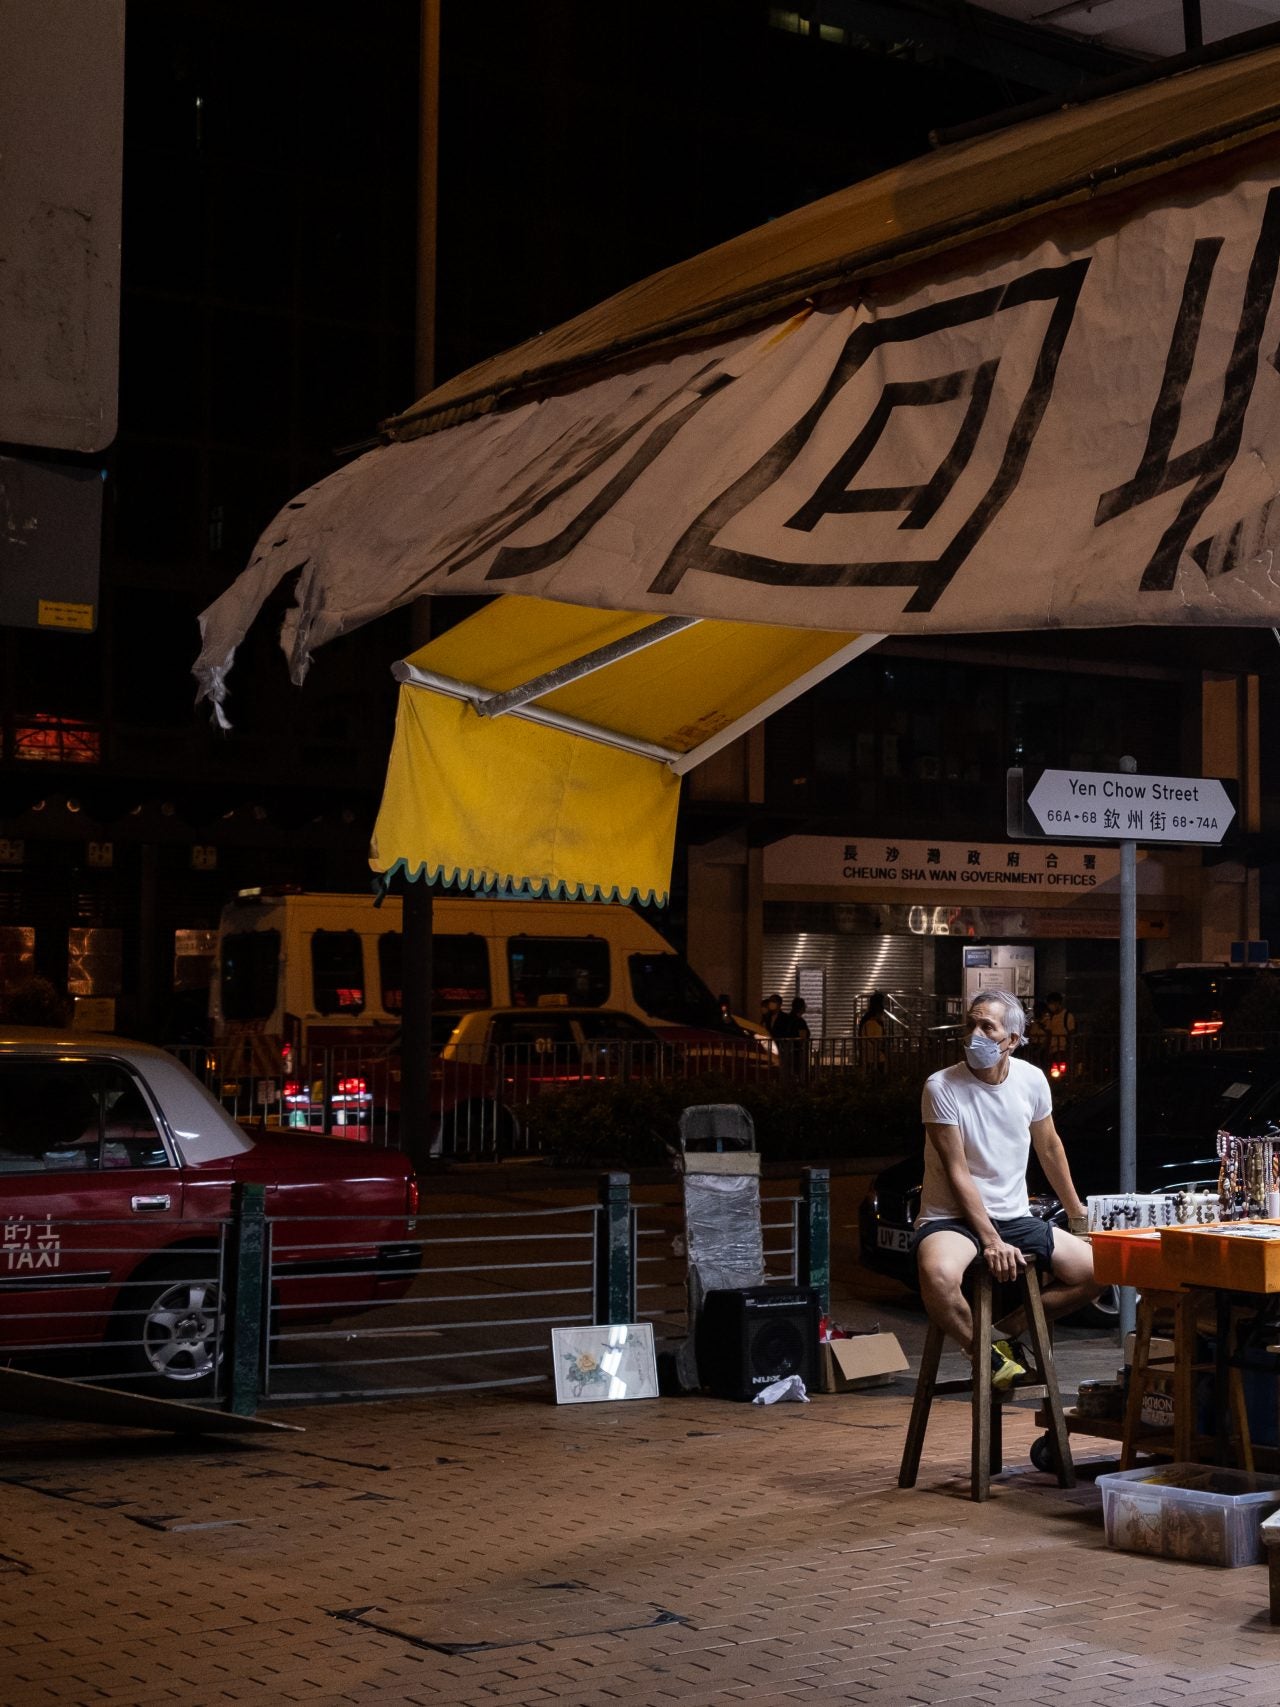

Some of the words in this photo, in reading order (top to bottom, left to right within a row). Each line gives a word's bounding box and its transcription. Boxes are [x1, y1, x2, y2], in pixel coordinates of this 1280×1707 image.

[1069, 778, 1097, 797] Yen
[1102, 780, 1147, 799] Chow
[1152, 783, 1200, 802] Street
[843, 866, 897, 880] CHEUNG
[901, 868, 926, 881] SHA
[929, 869, 957, 882] WAN
[960, 870, 1044, 885] GOVERNMENT
[1047, 873, 1097, 886] OFFICES
[880, 1229, 894, 1246] UV
[2, 1240, 61, 1270] TAXI
